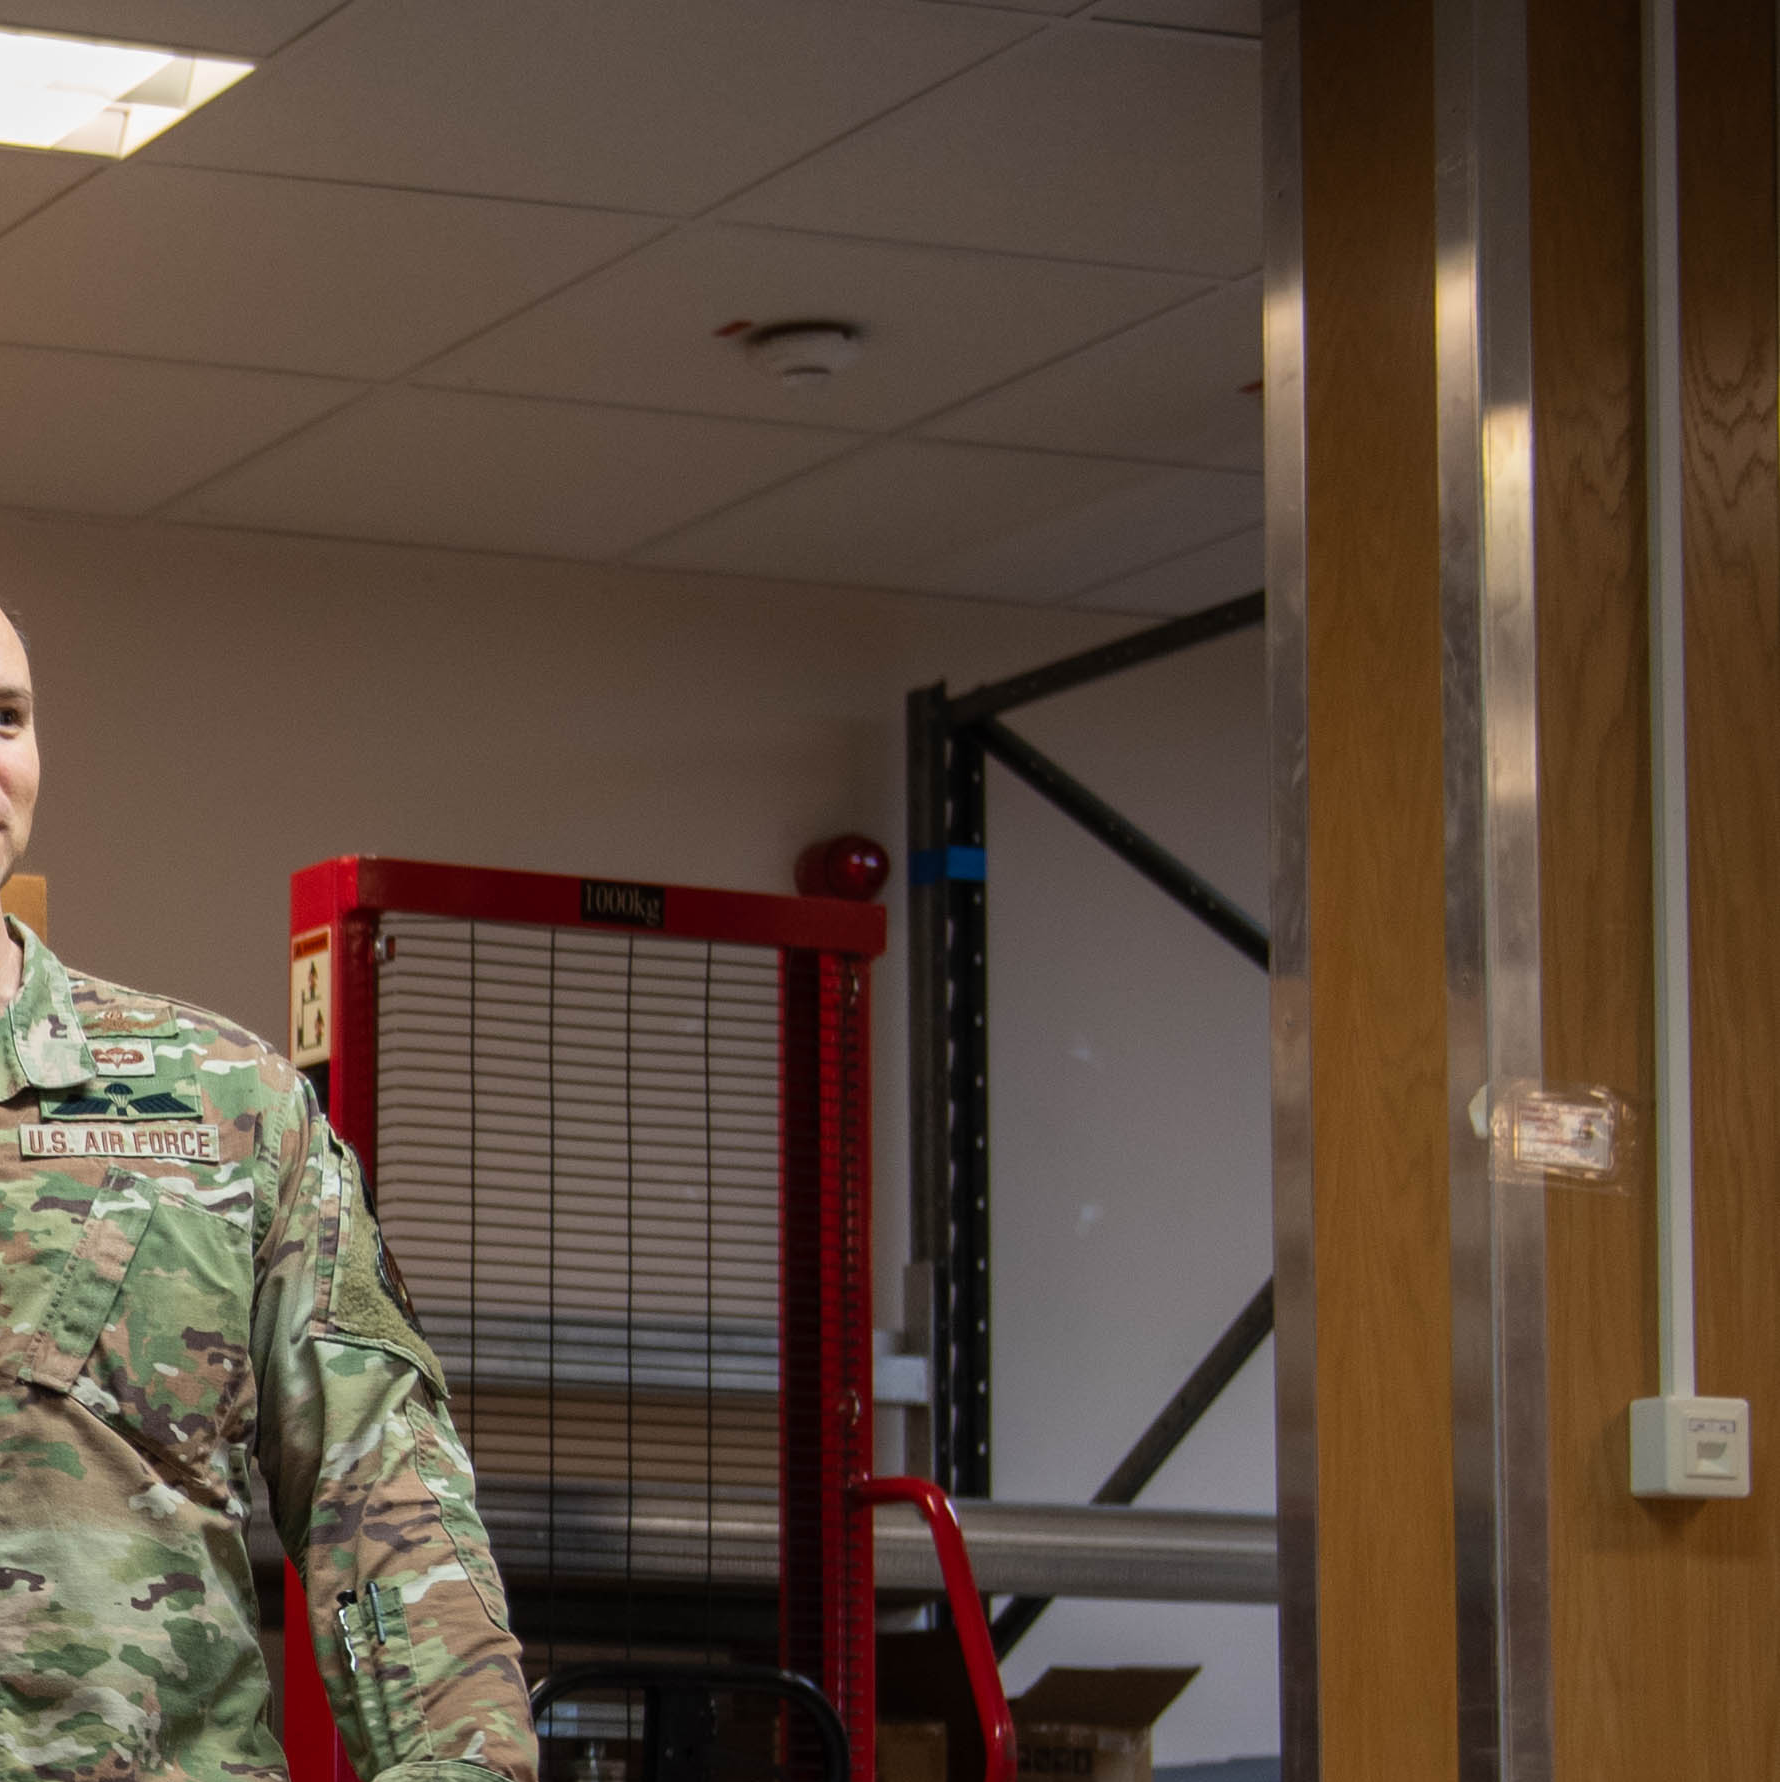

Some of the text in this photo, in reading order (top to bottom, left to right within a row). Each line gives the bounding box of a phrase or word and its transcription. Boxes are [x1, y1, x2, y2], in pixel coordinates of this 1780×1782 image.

[585, 884, 661, 927] 1000kg
[29, 1129, 211, 1159] U.S. AIR FORCE
